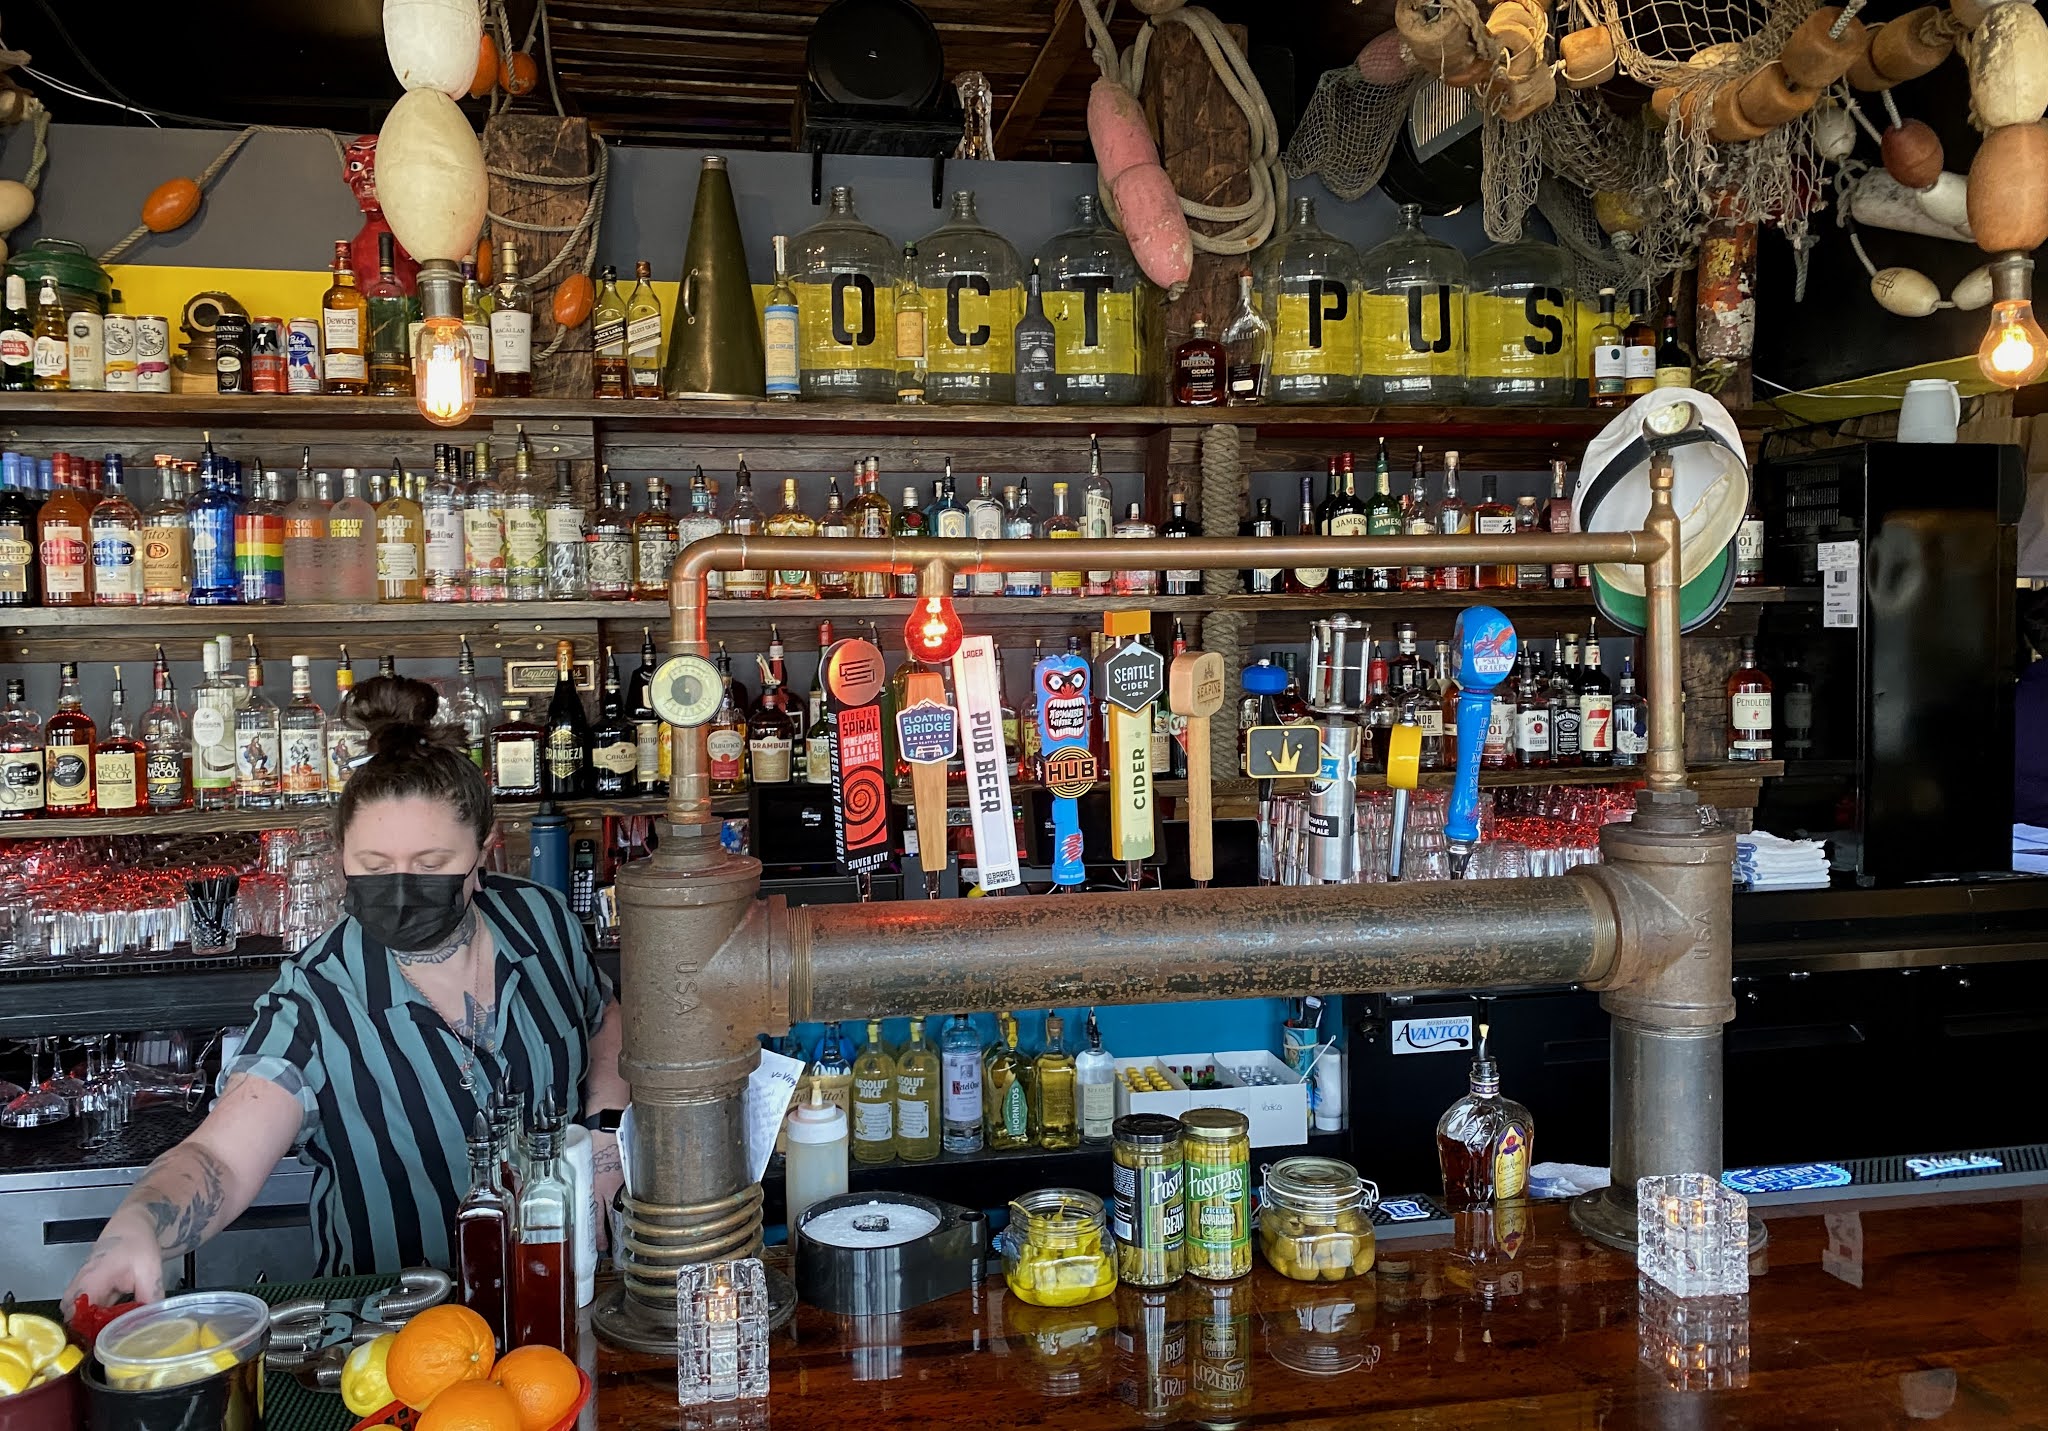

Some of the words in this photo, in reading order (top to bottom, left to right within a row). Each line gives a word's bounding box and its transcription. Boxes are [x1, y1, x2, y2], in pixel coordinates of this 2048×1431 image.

[495, 327, 526, 335] MACALLAN
[504, 340, 515, 348] 12
[73, 345, 90, 358] DRY
[691, 494, 709, 504] ALTO
[377, 518, 413, 529] ABSOLUT
[1336, 517, 1367, 528] JAMESO
[1374, 518, 1402, 529] JAMESO
[382, 528, 405, 538] JUICE
[962, 648, 983, 659] LAGER
[1114, 664, 1155, 684] SEATTLE
[1478, 663, 1509, 672] KRAKEN
[1120, 681, 1149, 691] CIDER
[1196, 681, 1222, 698] SEAPINE
[841, 711, 860, 722] RIDE
[863, 708, 877, 718] THE
[902, 713, 952, 725] FLOATING
[842, 718, 878, 737] SPIRAL
[903, 723, 952, 735] BRIDGE
[971, 711, 995, 754] PUB
[1587, 709, 1612, 748] 7
[843, 732, 879, 748] PINEAPPLE
[906, 733, 950, 742] BREWING
[752, 741, 790, 750] DRAMBUIE
[829, 731, 840, 772] SILVER
[844, 743, 879, 758] ORANGE
[545, 746, 584, 761] GRANDEZA
[844, 756, 868, 767] DOUBLE
[868, 753, 880, 763] IPA
[105, 763, 130, 772] REAL
[154, 761, 179, 770] REAL
[1048, 760, 1095, 782] HUB
[8, 770, 38, 778] KRAKEN
[1132, 747, 1146, 810] CIDER
[27, 788, 40, 797] 94
[832, 774, 842, 803] CITY
[975, 759, 1002, 814] BEER
[833, 806, 845, 864] BREWERY
[1316, 828, 1330, 836] ALE
[848, 855, 873, 871] SILVER
[873, 851, 889, 864] CITY
[676, 959, 698, 1016] USA
[1426, 1018, 1470, 1027] REFRIGERATION
[1394, 1022, 1470, 1045] AVANTCO
[855, 1078, 889, 1090] ABSOLUT
[859, 1088, 882, 1099] JUICE
[1011, 1086, 1021, 1133] HORNITOS
[1188, 1166, 1243, 1199] FOSTER'S
[1200, 1212, 1235, 1225] ASPARAGUS
